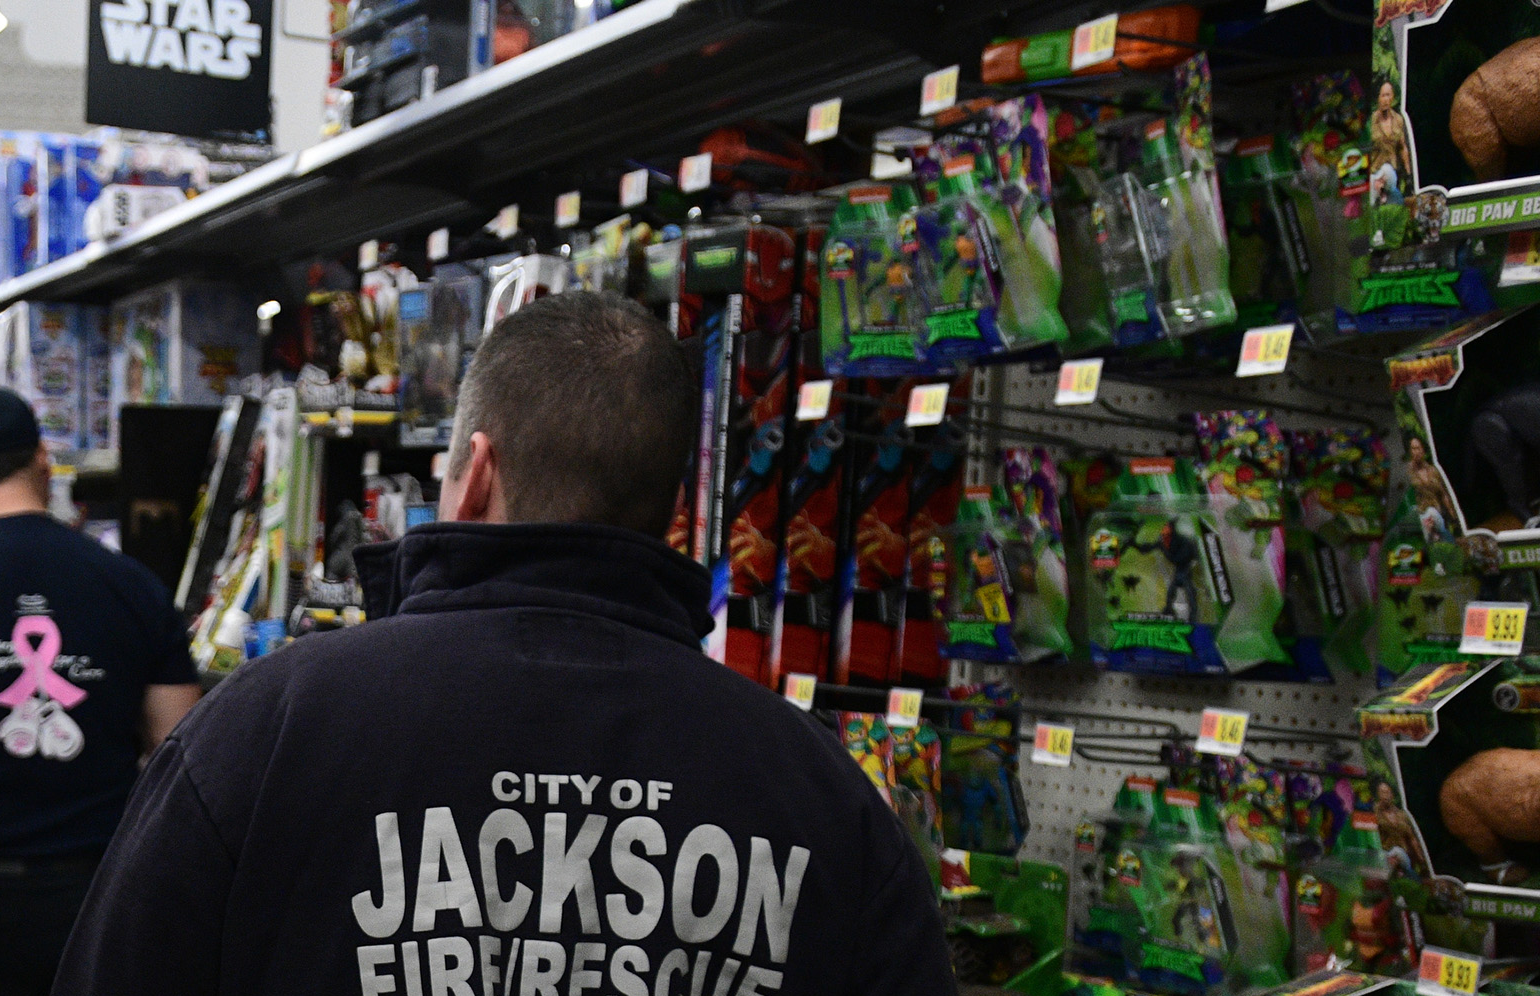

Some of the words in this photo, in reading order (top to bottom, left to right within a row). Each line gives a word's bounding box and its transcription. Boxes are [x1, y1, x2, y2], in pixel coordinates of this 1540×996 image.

[100, 0, 262, 38] STAR
[100, 20, 262, 81] WARS
[1451, 206, 1478, 226] BIG
[1481, 200, 1518, 222] PAW
[491, 770, 602, 805] CITY
[609, 778, 674, 811] OF
[351, 806, 811, 964] JACKSON
